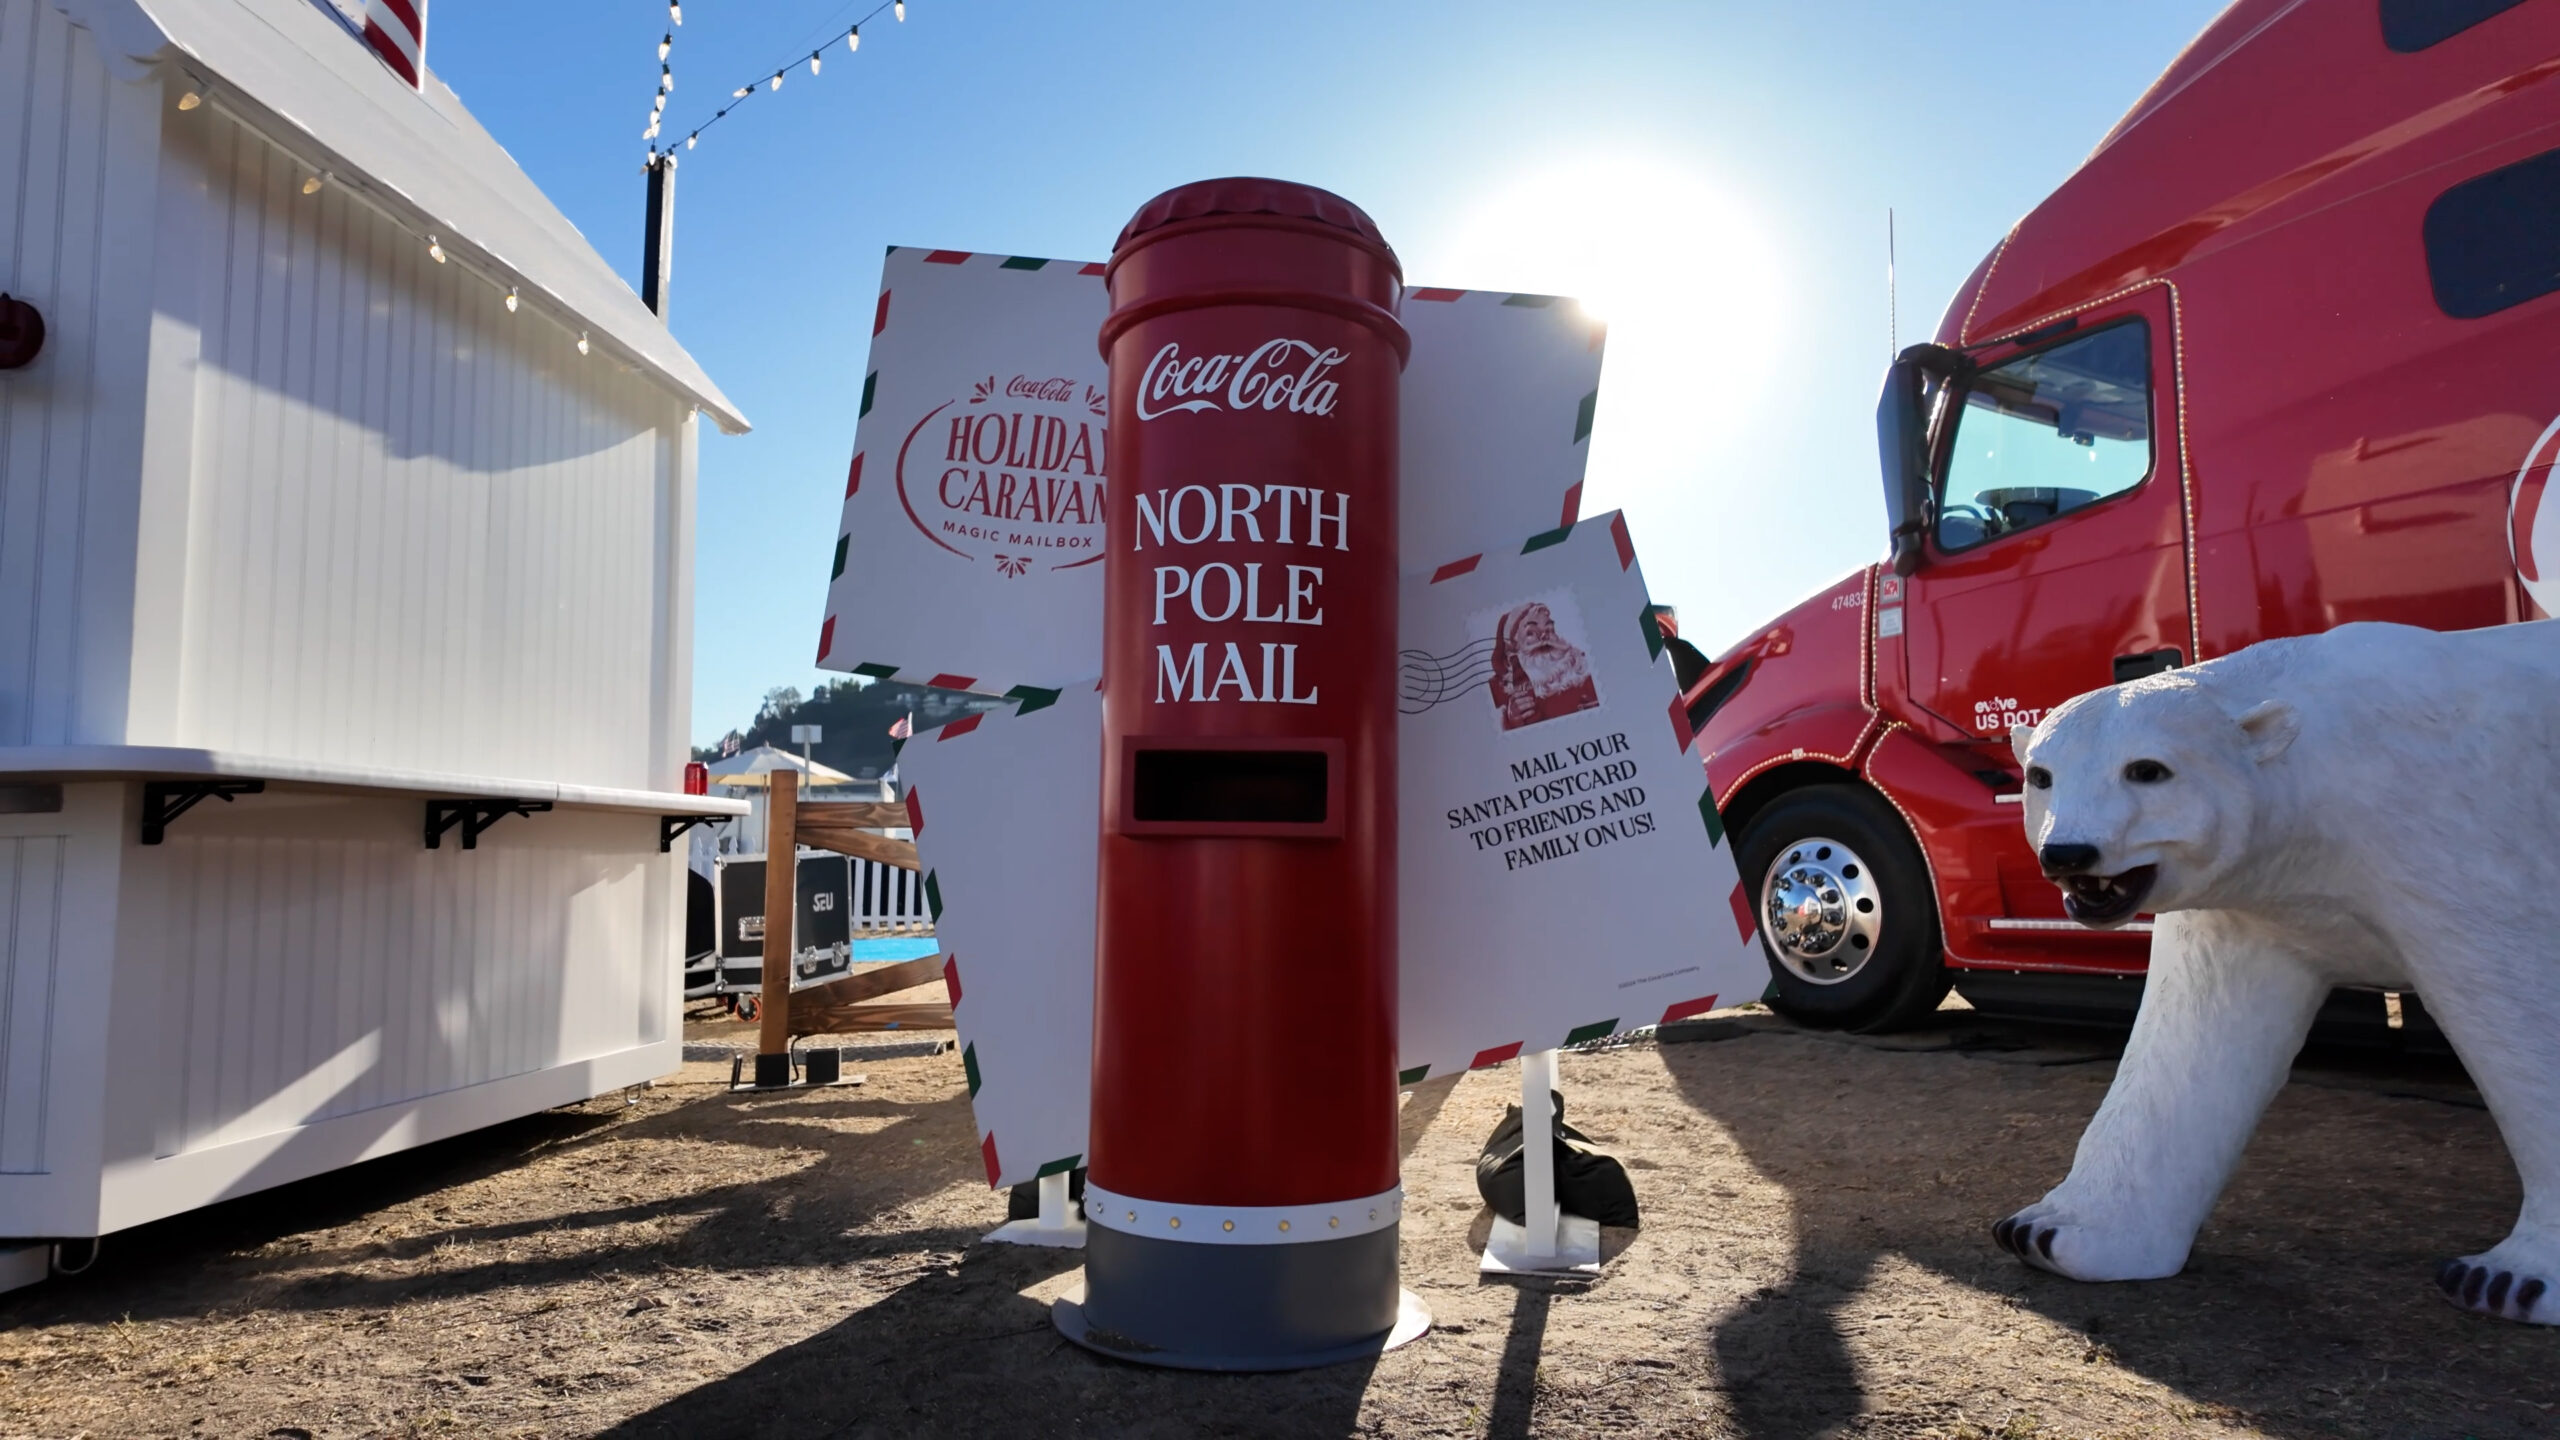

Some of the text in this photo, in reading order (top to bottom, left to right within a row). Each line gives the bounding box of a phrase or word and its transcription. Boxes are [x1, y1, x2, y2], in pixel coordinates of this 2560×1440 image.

[1005, 374, 1078, 402] Coca-Cola
[1136, 338, 1351, 421] Coca-Cola
[943, 520, 1093, 548] MAGIC MAILBOX
[1134, 483, 1350, 551] NORTH
[1152, 562, 1323, 626] POLE
[1155, 642, 1318, 704] MAIL
[1975, 713, 1999, 730] US
[2003, 708, 2041, 728] DOT
[1510, 732, 1630, 783] MAIL YOUR
[1447, 759, 1637, 829] SANTA POSTCARD
[1470, 786, 1646, 851] TO FRIENDS AND
[1504, 811, 1656, 871] FAMILY ON US!
